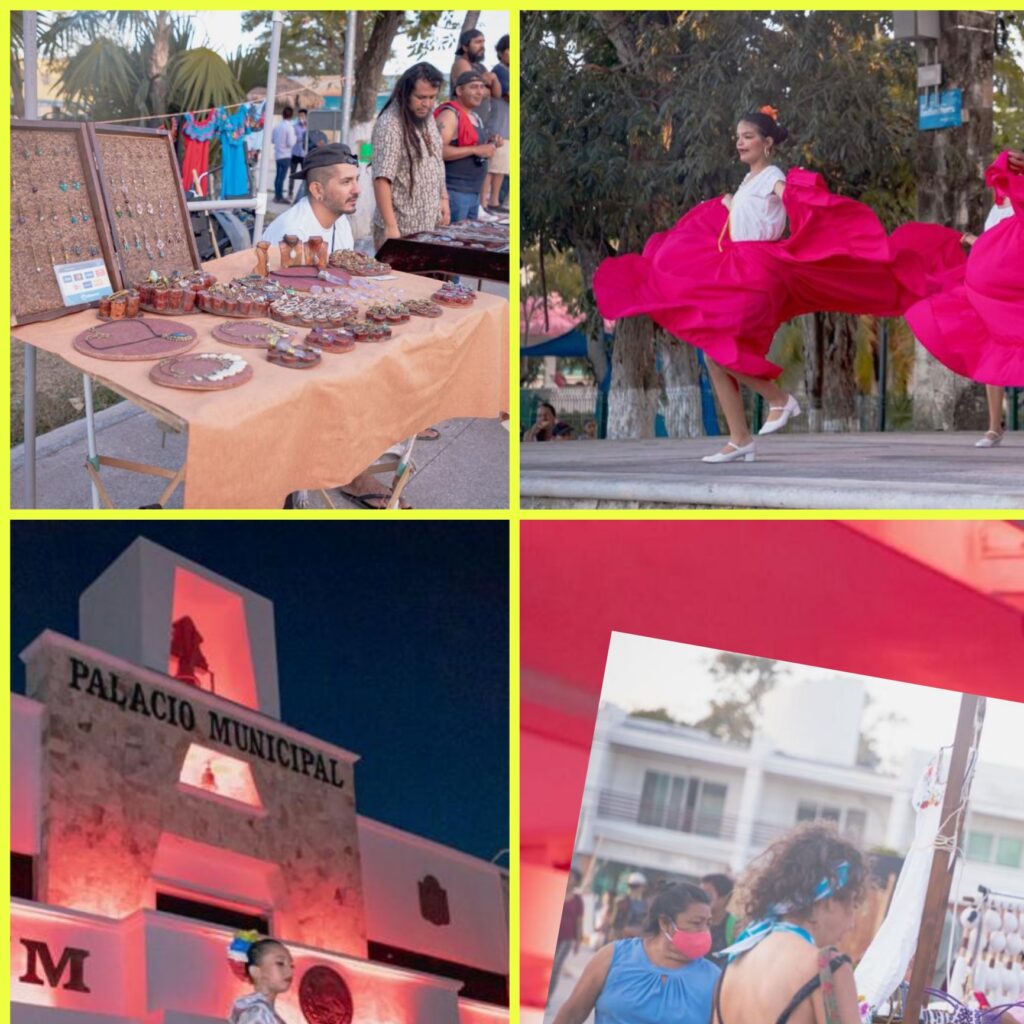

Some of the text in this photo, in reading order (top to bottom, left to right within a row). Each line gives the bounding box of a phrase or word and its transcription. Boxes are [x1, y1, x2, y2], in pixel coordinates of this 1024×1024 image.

[69, 657, 344, 788] PALACIO MUNICIPAL
[19, 938, 91, 993] M
